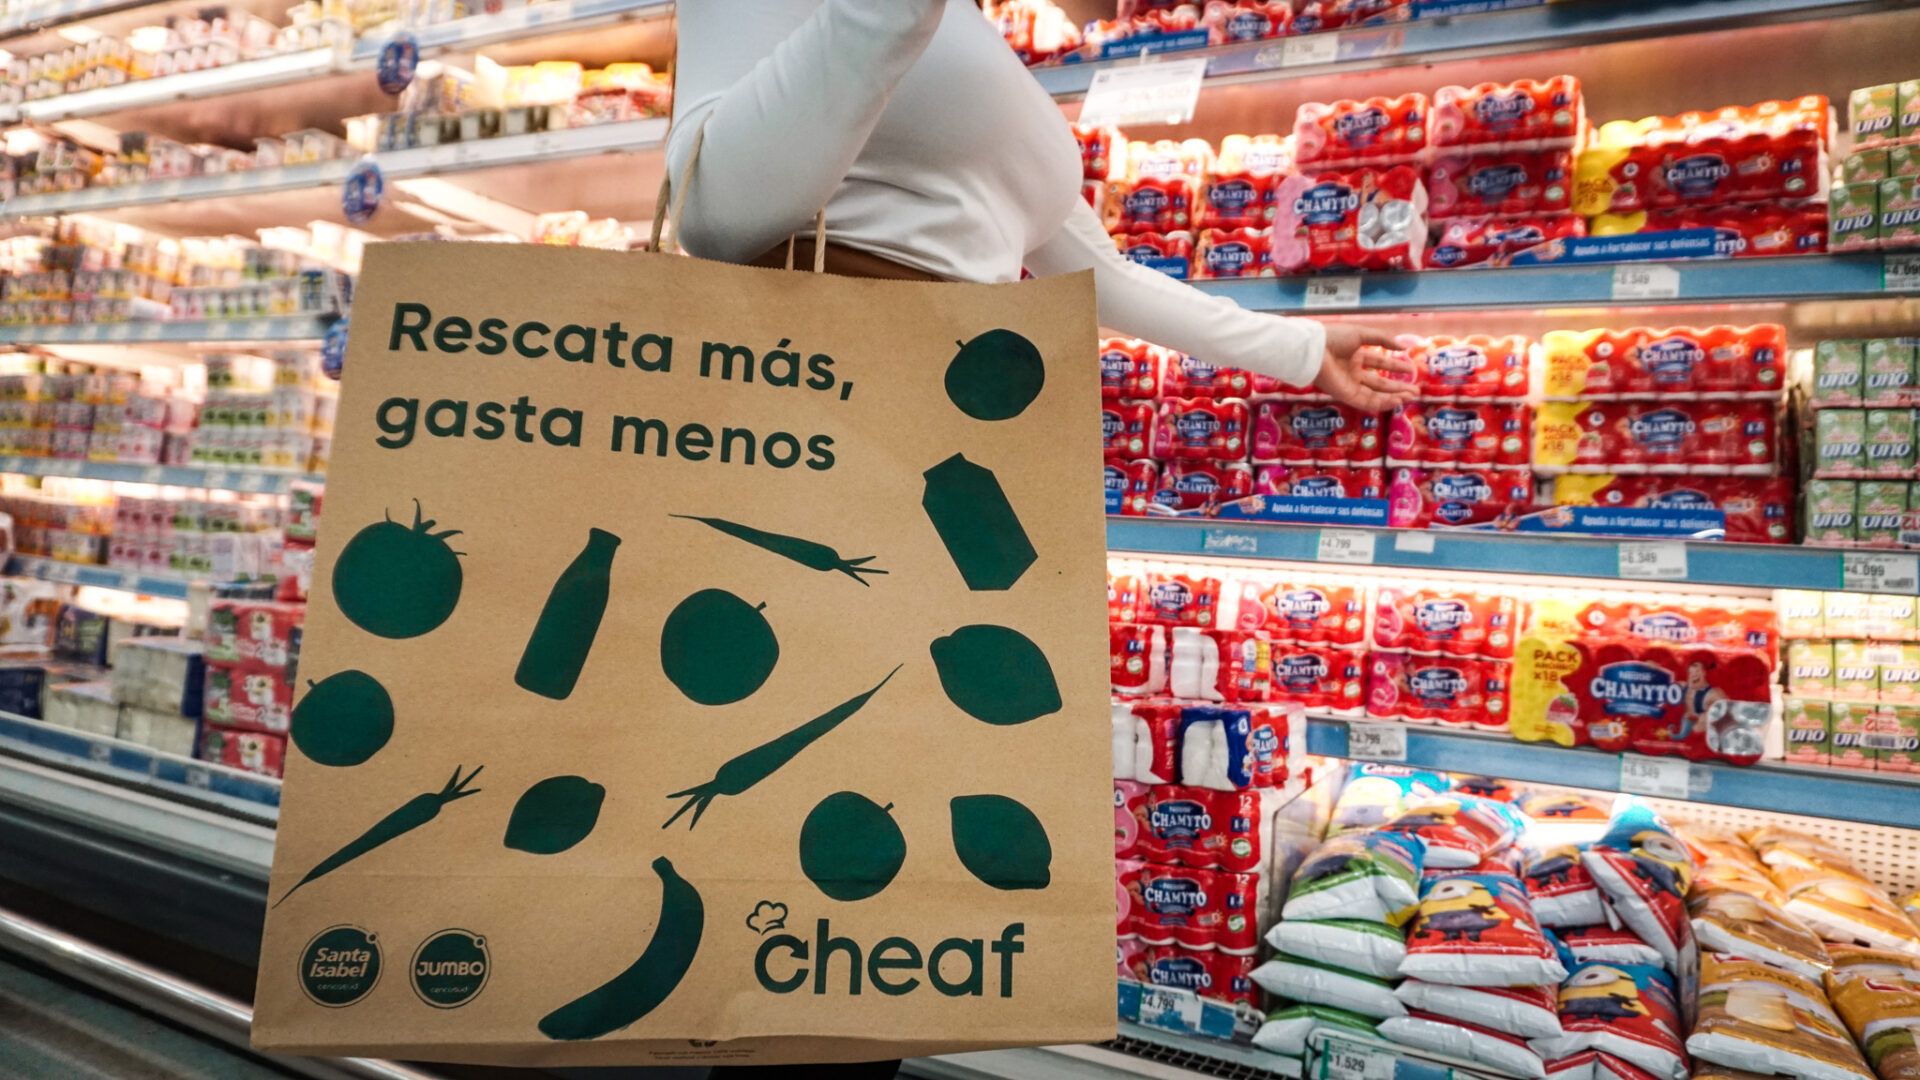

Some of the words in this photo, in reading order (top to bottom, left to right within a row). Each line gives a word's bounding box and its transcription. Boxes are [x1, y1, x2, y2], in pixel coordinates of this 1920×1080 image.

[1666, 163, 1731, 182] CHAMYTO
[1293, 192, 1359, 215] CHAMYTO
[1207, 249, 1254, 263] CHAMYTO
[388, 301, 674, 373] Rescata
[699, 337, 854, 401] más,
[1641, 348, 1705, 362] CHAMYTO
[1176, 419, 1221, 432] CHAMYTO
[1292, 416, 1345, 429] CHAMYTO
[1428, 418, 1485, 432] CHAMYTO
[1631, 420, 1696, 434] CHAMYTO
[375, 395, 584, 450] gasta
[610, 413, 837, 471] menos
[1292, 484, 1345, 498] CHAMYTO
[1434, 483, 1492, 497] CHAMYTO
[1436, 507, 1473, 517] CHAMYTO
[1277, 598, 1331, 613] CHAMYTO
[1416, 610, 1473, 624] CHAMYTO
[1632, 624, 1697, 640] CHAMYTO
[1534, 650, 1578, 663] PACK
[1276, 662, 1328, 677] CHAMYTO
[1410, 678, 1468, 692] CHAMYTO
[1590, 677, 1682, 705] CHAMYTO
[1238, 794, 1253, 811] 12
[1151, 811, 1212, 830] CHAMYTO
[1235, 874, 1250, 886] 12
[1144, 887, 1207, 907] CHAMYTO
[314, 947, 372, 963] Santa
[754, 918, 1025, 998] cheaf
[309, 961, 369, 978] Isabel
[416, 960, 485, 977] JUMBO
[1150, 969, 1212, 988] CHAMYTO
